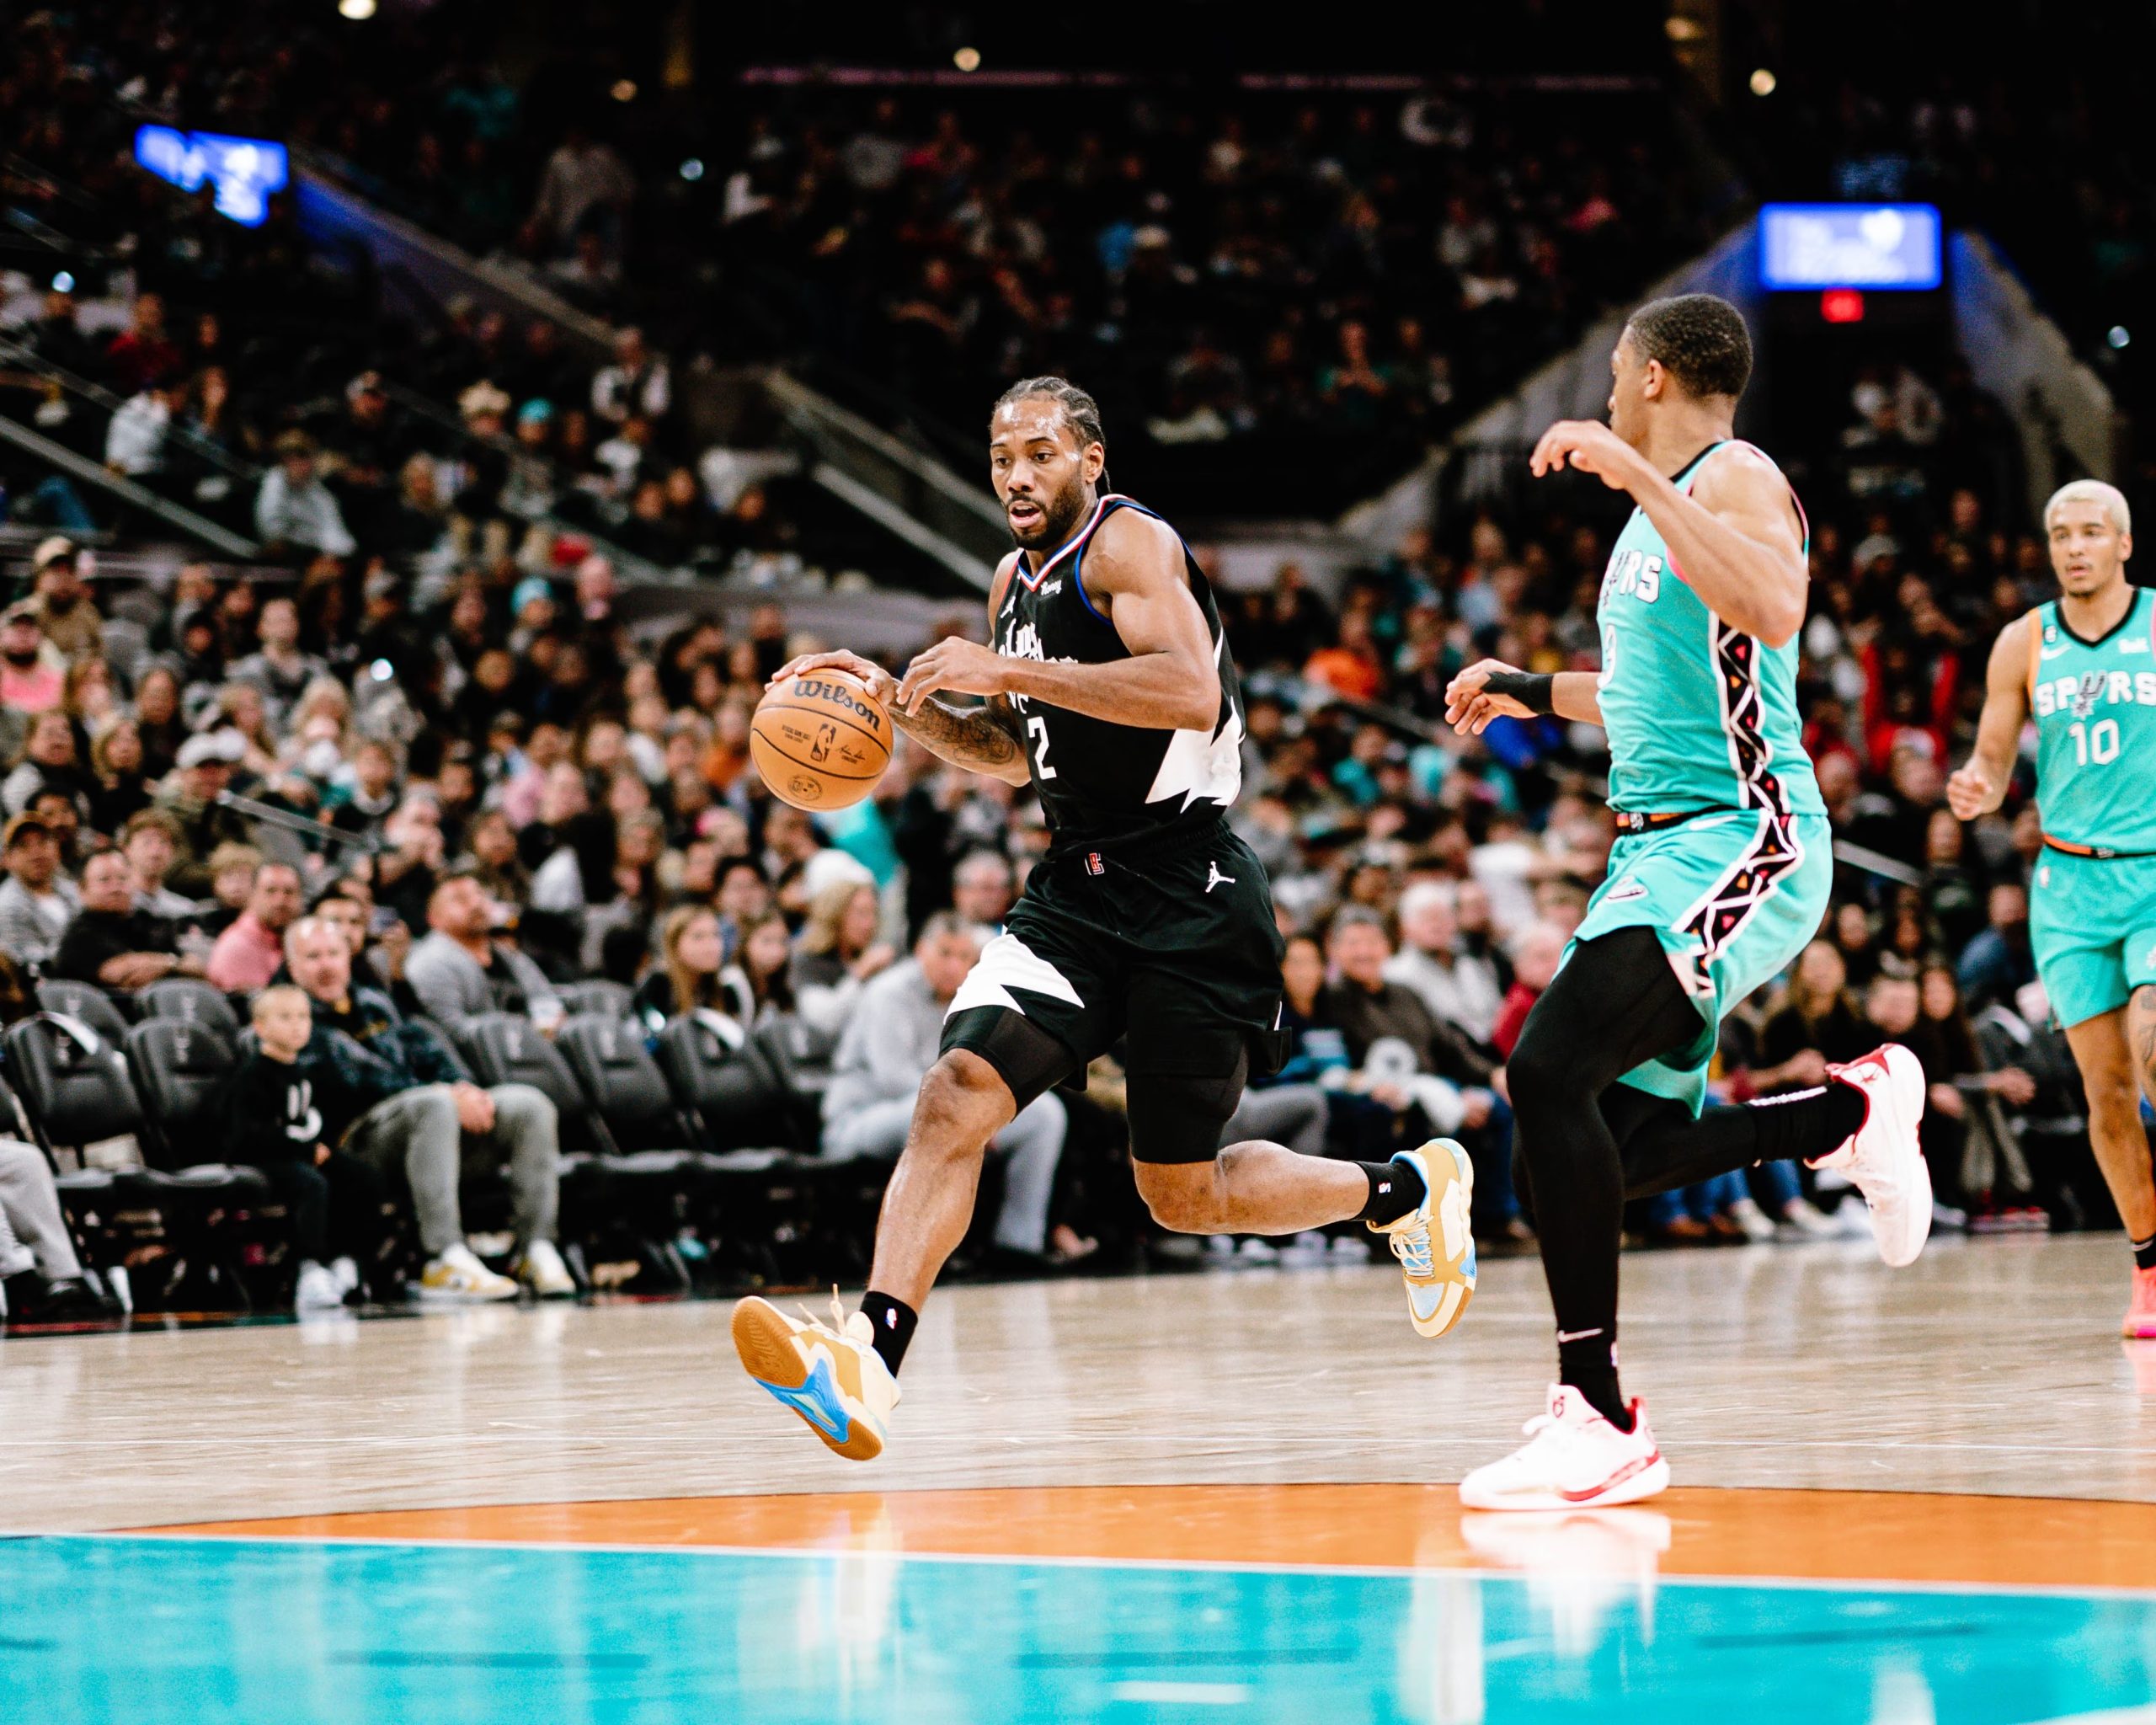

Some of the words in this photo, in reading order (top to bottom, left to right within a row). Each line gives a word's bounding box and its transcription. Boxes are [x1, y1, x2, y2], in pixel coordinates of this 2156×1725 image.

[1600, 550, 1663, 608] URS
[794, 680, 880, 732] Wilson
[2036, 670, 2156, 720] SPURS
[1027, 716, 1057, 780] 2
[2069, 719, 2120, 766] 10
